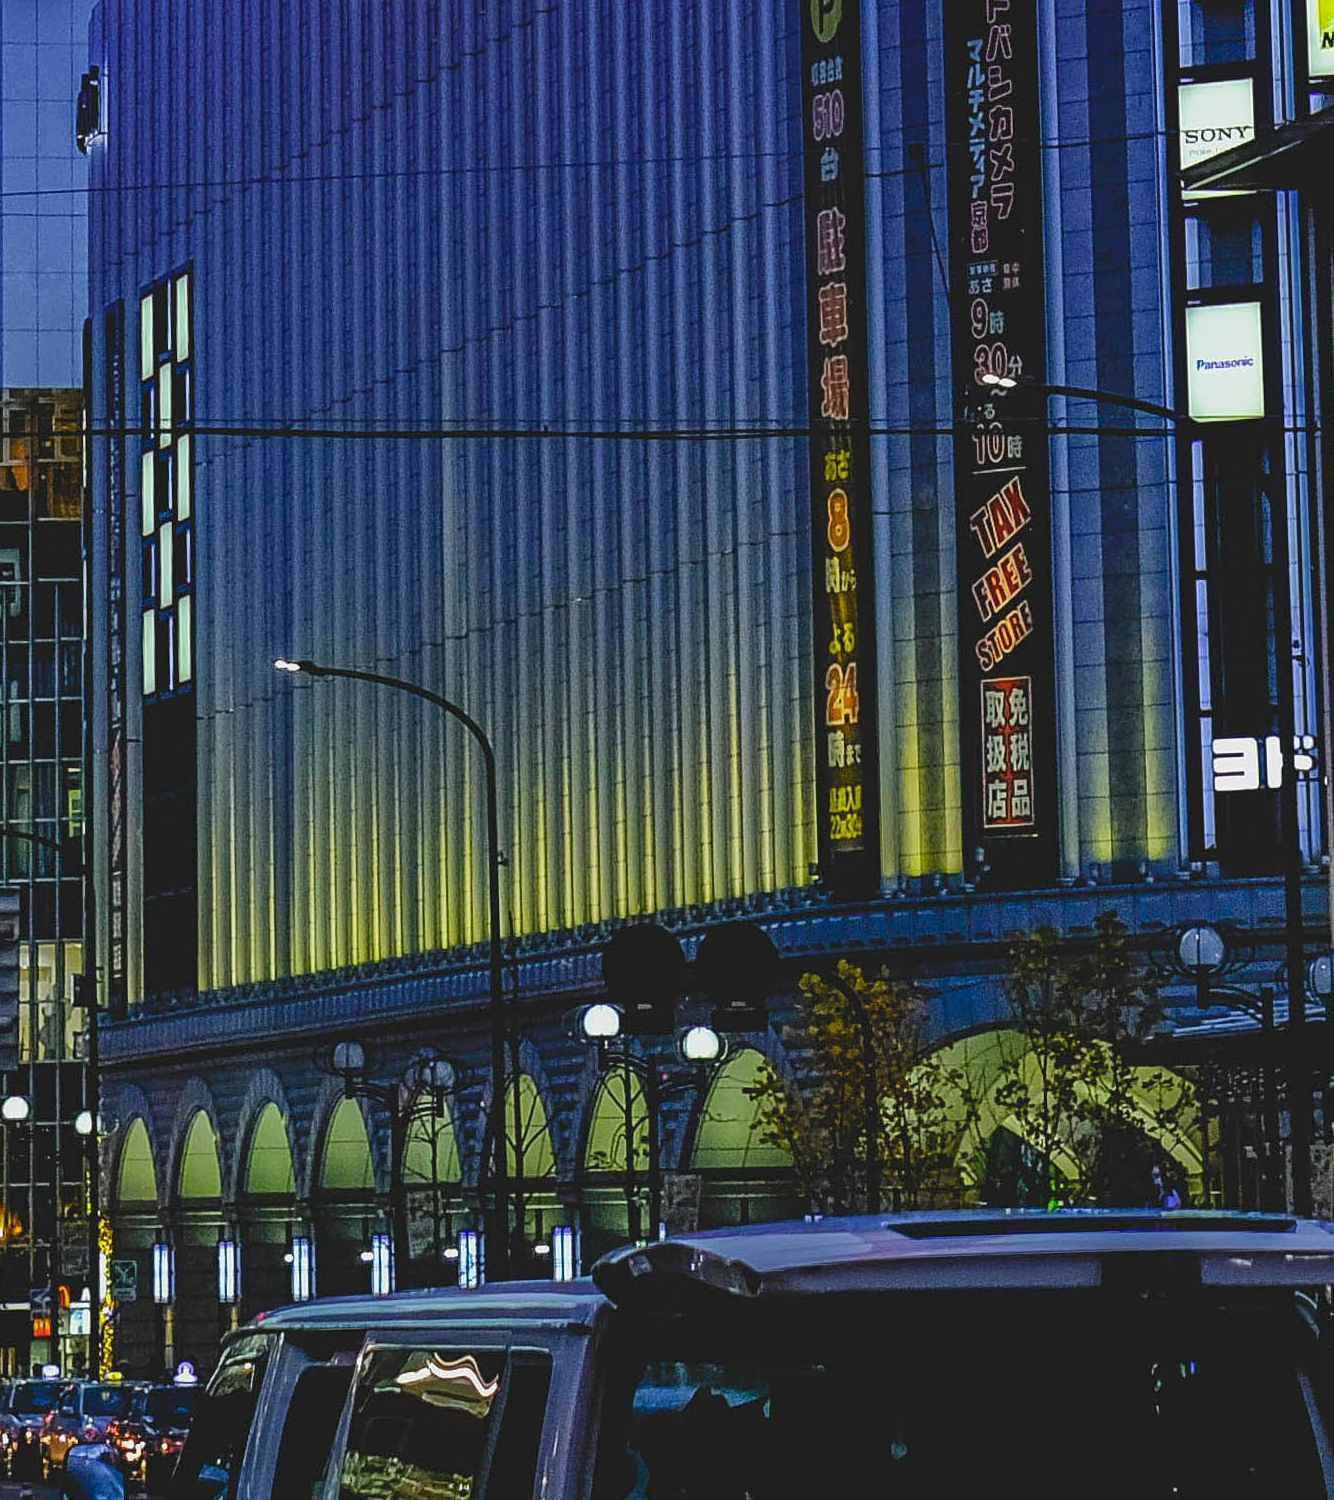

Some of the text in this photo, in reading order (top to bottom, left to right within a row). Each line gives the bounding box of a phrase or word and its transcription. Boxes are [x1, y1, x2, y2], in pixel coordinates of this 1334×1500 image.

[1185, 126, 1252, 144] SONY
[1196, 355, 1255, 371] Panasonic
[827, 487, 851, 553] 8
[970, 475, 1032, 559] TAX
[972, 542, 1033, 623] FREE
[975, 599, 1034, 672] STORE
[825, 661, 860, 726] 24
[985, 690, 1007, 819] 取扱店
[1008, 687, 1031, 817] 免税品
